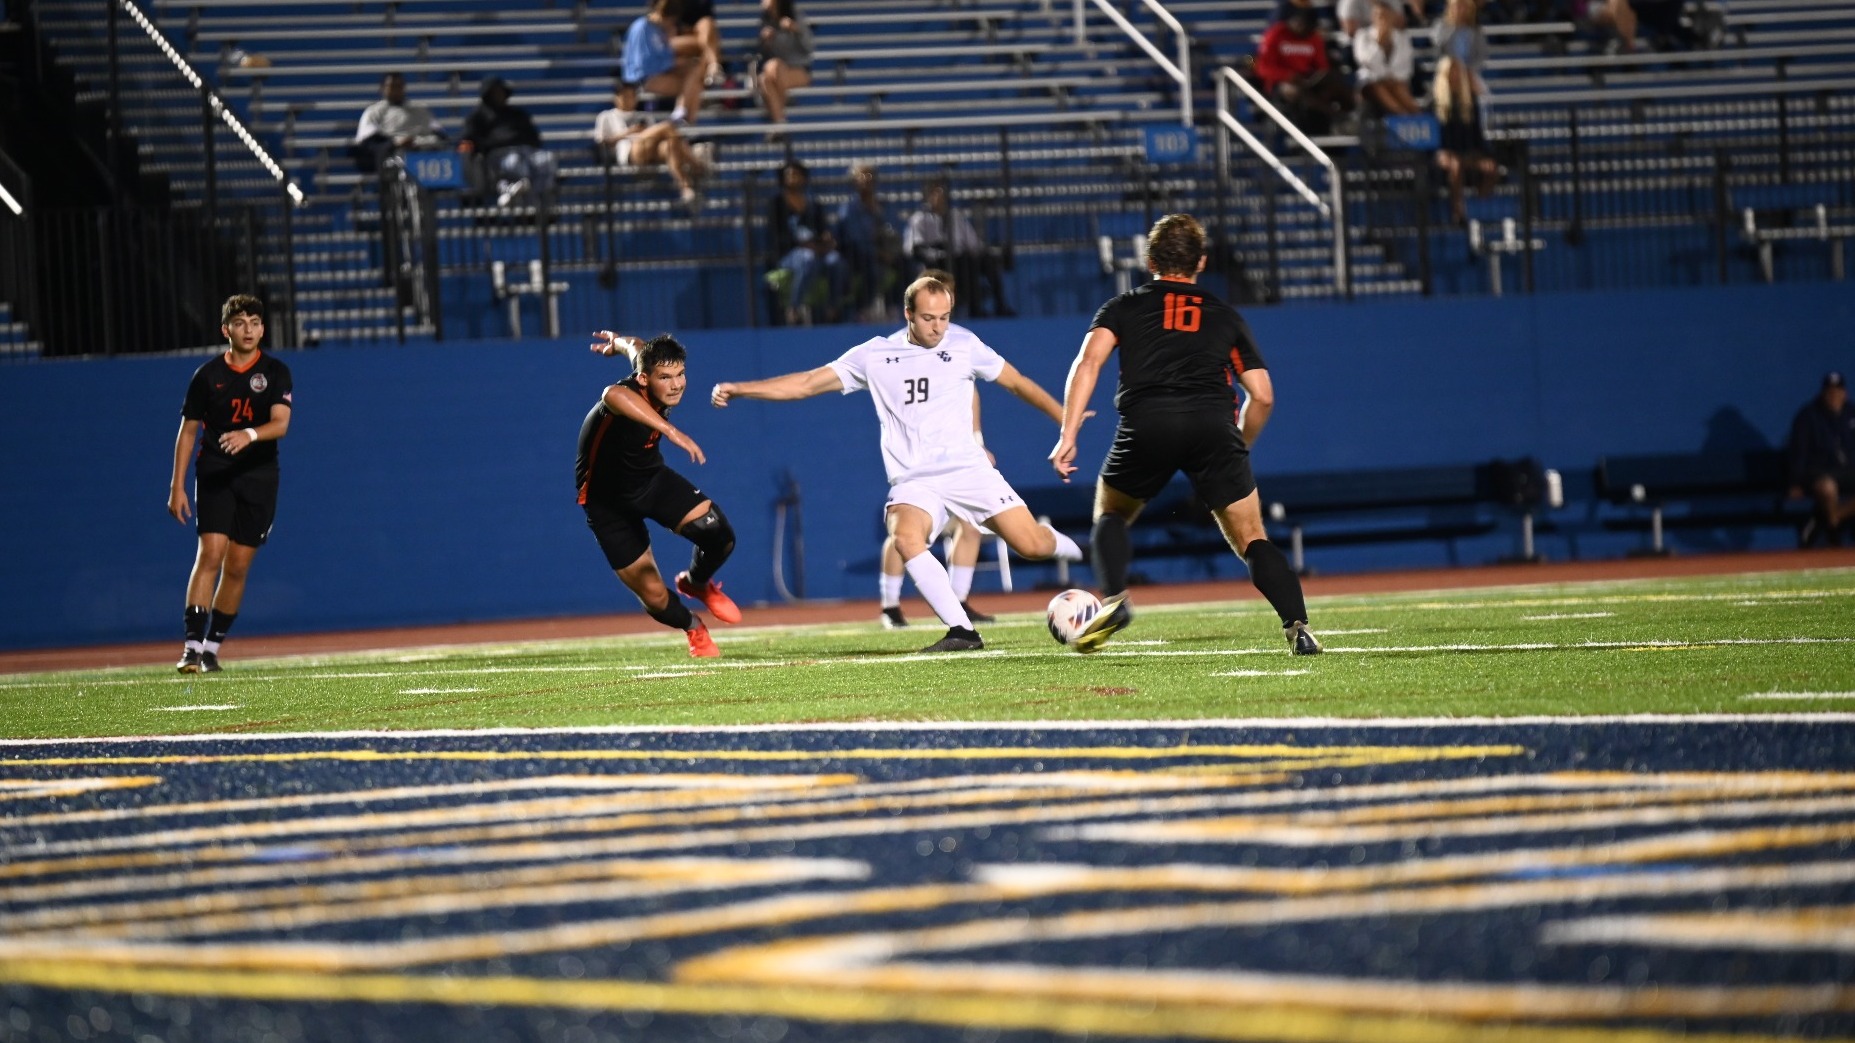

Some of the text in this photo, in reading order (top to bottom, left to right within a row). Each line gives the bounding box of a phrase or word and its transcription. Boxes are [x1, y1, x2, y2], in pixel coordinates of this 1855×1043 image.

[417, 158, 452, 181] 103
[1163, 292, 1202, 332] 16
[904, 377, 929, 405] 39
[231, 398, 254, 422] 24
